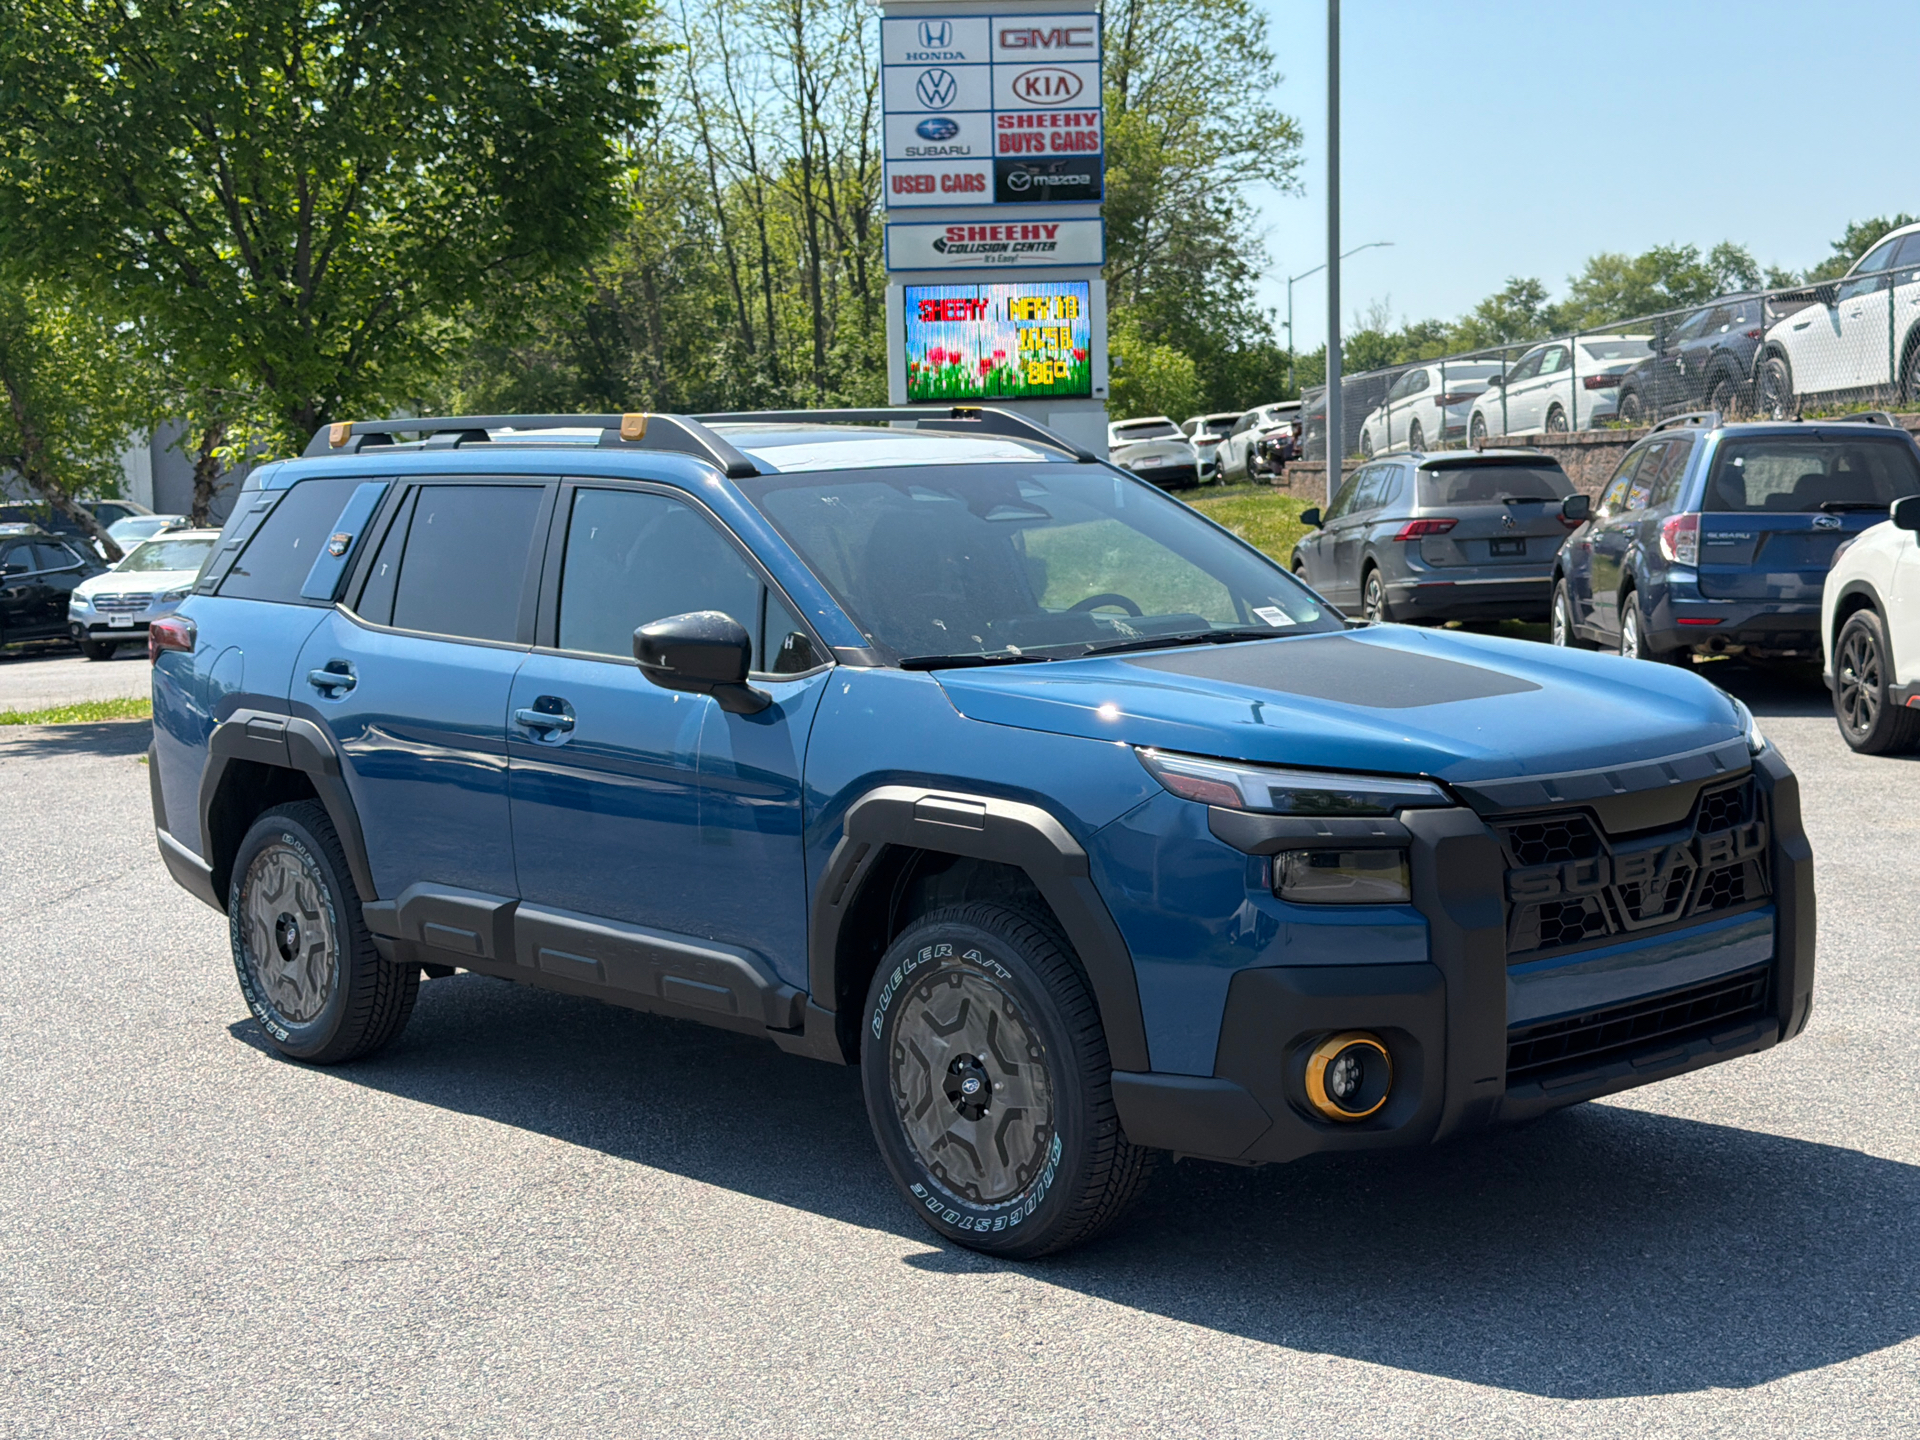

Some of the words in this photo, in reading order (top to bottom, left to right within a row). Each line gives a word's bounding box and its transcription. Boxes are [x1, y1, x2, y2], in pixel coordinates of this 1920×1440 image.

[1000, 27, 1094, 49] GMC
[905, 52, 966, 61] HONDA
[1025, 76, 1071, 96] KIA
[997, 113, 1098, 129] SHEEHY
[905, 146, 971, 157] SUBARU
[999, 132, 1045, 153] BUYS
[1050, 131, 1098, 152] CARS
[892, 174, 935, 194] USED
[941, 173, 986, 192] CARS
[946, 224, 1060, 243] SHEEHY
[947, 242, 1010, 254] COLLISION
[1012, 241, 1058, 252] CENTER
[984, 254, 996, 263] It's
[997, 253, 1019, 264] Easy!
[1508, 821, 1766, 900] SUBARU
[871, 943, 953, 1040] DUELER
[962, 949, 1012, 980] A/T
[909, 1131, 1063, 1232] BRIDGESTONE
